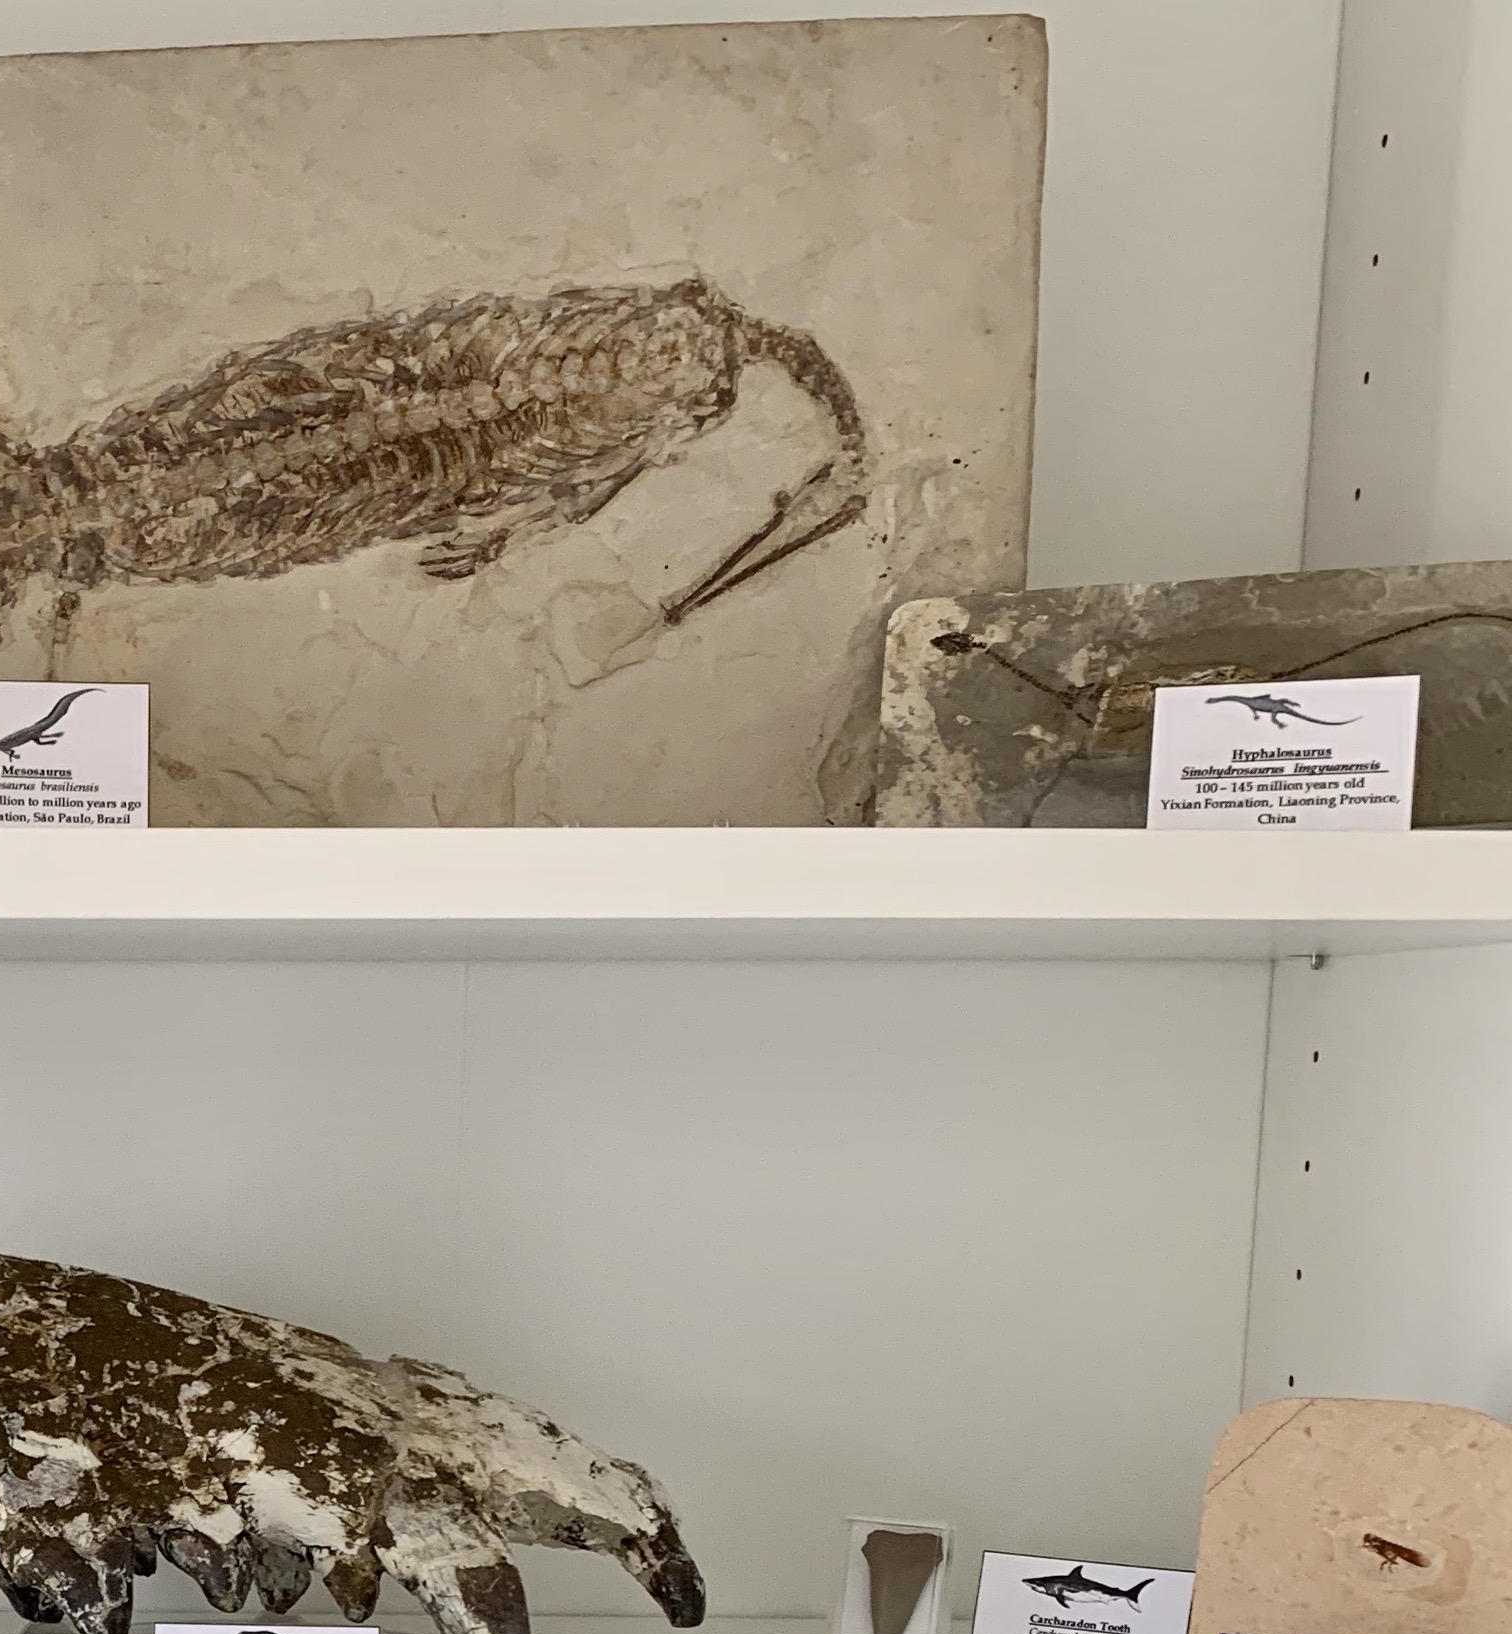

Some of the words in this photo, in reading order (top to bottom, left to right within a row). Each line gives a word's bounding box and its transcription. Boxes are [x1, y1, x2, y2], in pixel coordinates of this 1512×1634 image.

[1232, 747, 1332, 761] Hyphalosaurus
[2, 765, 72, 777] Mesosaurus
[1182, 765, 1284, 778] Sinohydrosaurus
[1294, 761, 1380, 775] lingyuanensis
[41, 781, 99, 792] brasiliensis
[1196, 782, 1218, 793] 100
[1232, 781, 1252, 792] 145
[1257, 779, 1303, 792] million
[1305, 779, 1339, 792] years
[1344, 777, 1364, 788] old
[28, 796, 38, 806] to
[43, 796, 84, 808] million
[87, 800, 116, 810] years
[120, 800, 141, 811] ago
[1161, 799, 1201, 810] Yixian
[1205, 798, 1273, 809] Formation,
[1279, 796, 1336, 808] Liaoning
[1340, 793, 1400, 805] Province,
[34, 812, 54, 823] São
[58, 813, 94, 825] Paulo,
[97, 813, 130, 824] Brazil
[1258, 813, 1296, 824] China
[1030, 1614, 1096, 1630] Carcharadon
[1101, 1622, 1130, 1633] Tooth
